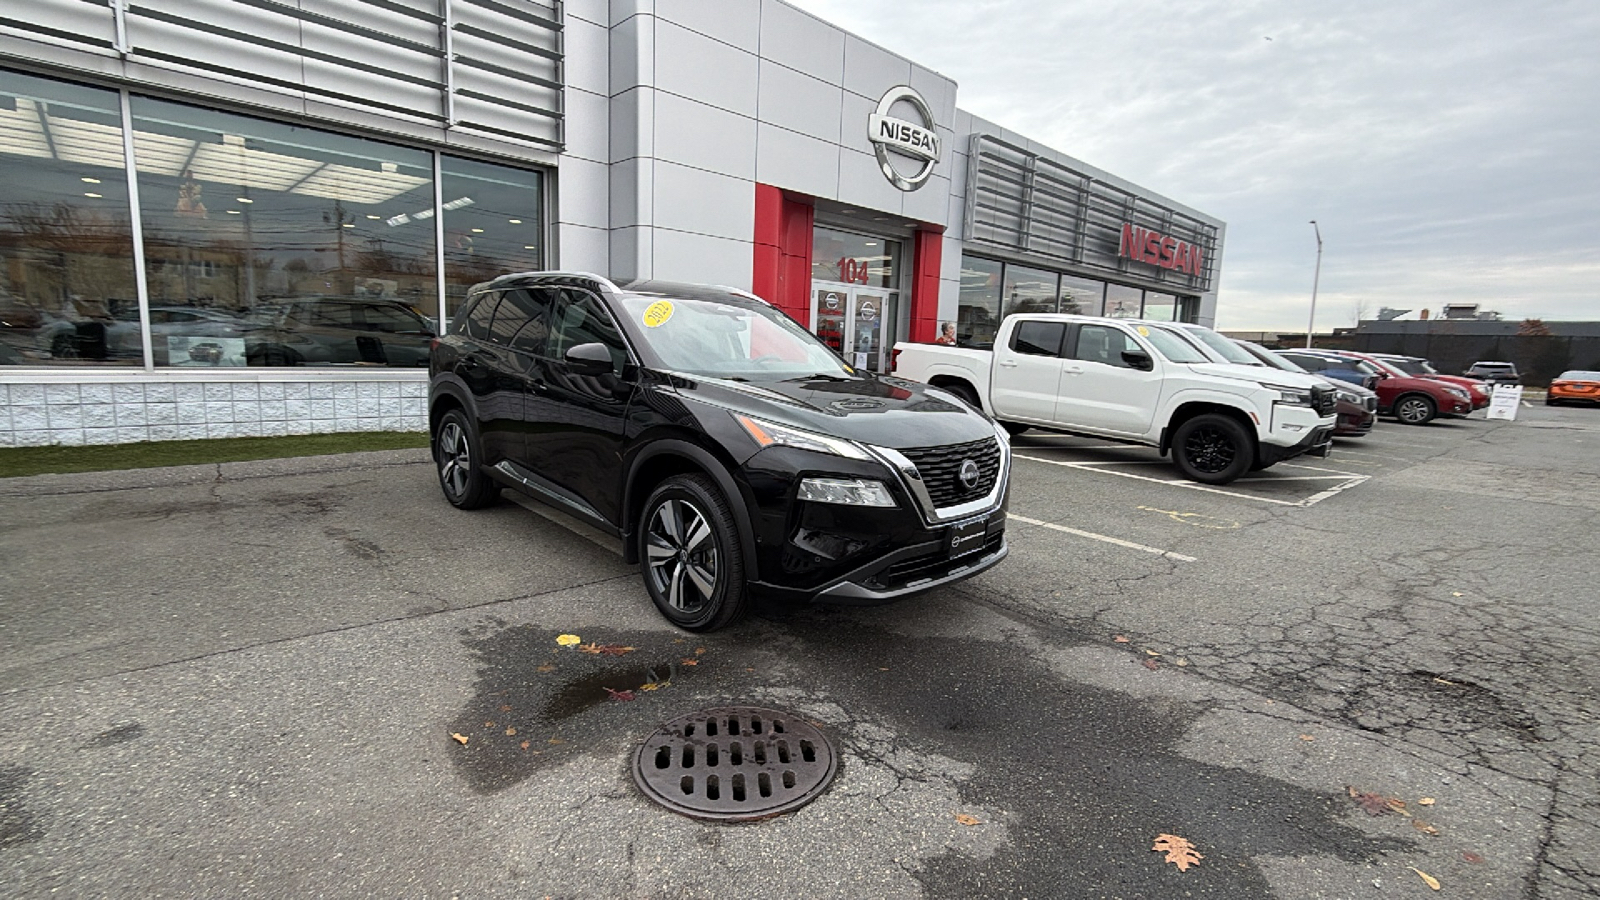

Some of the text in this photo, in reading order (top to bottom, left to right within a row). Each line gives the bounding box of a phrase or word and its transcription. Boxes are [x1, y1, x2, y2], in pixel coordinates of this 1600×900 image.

[880, 120, 939, 155] NISSAN
[1120, 222, 1203, 276] NISSAN
[837, 256, 869, 285] 104
[647, 302, 669, 324] 2022
